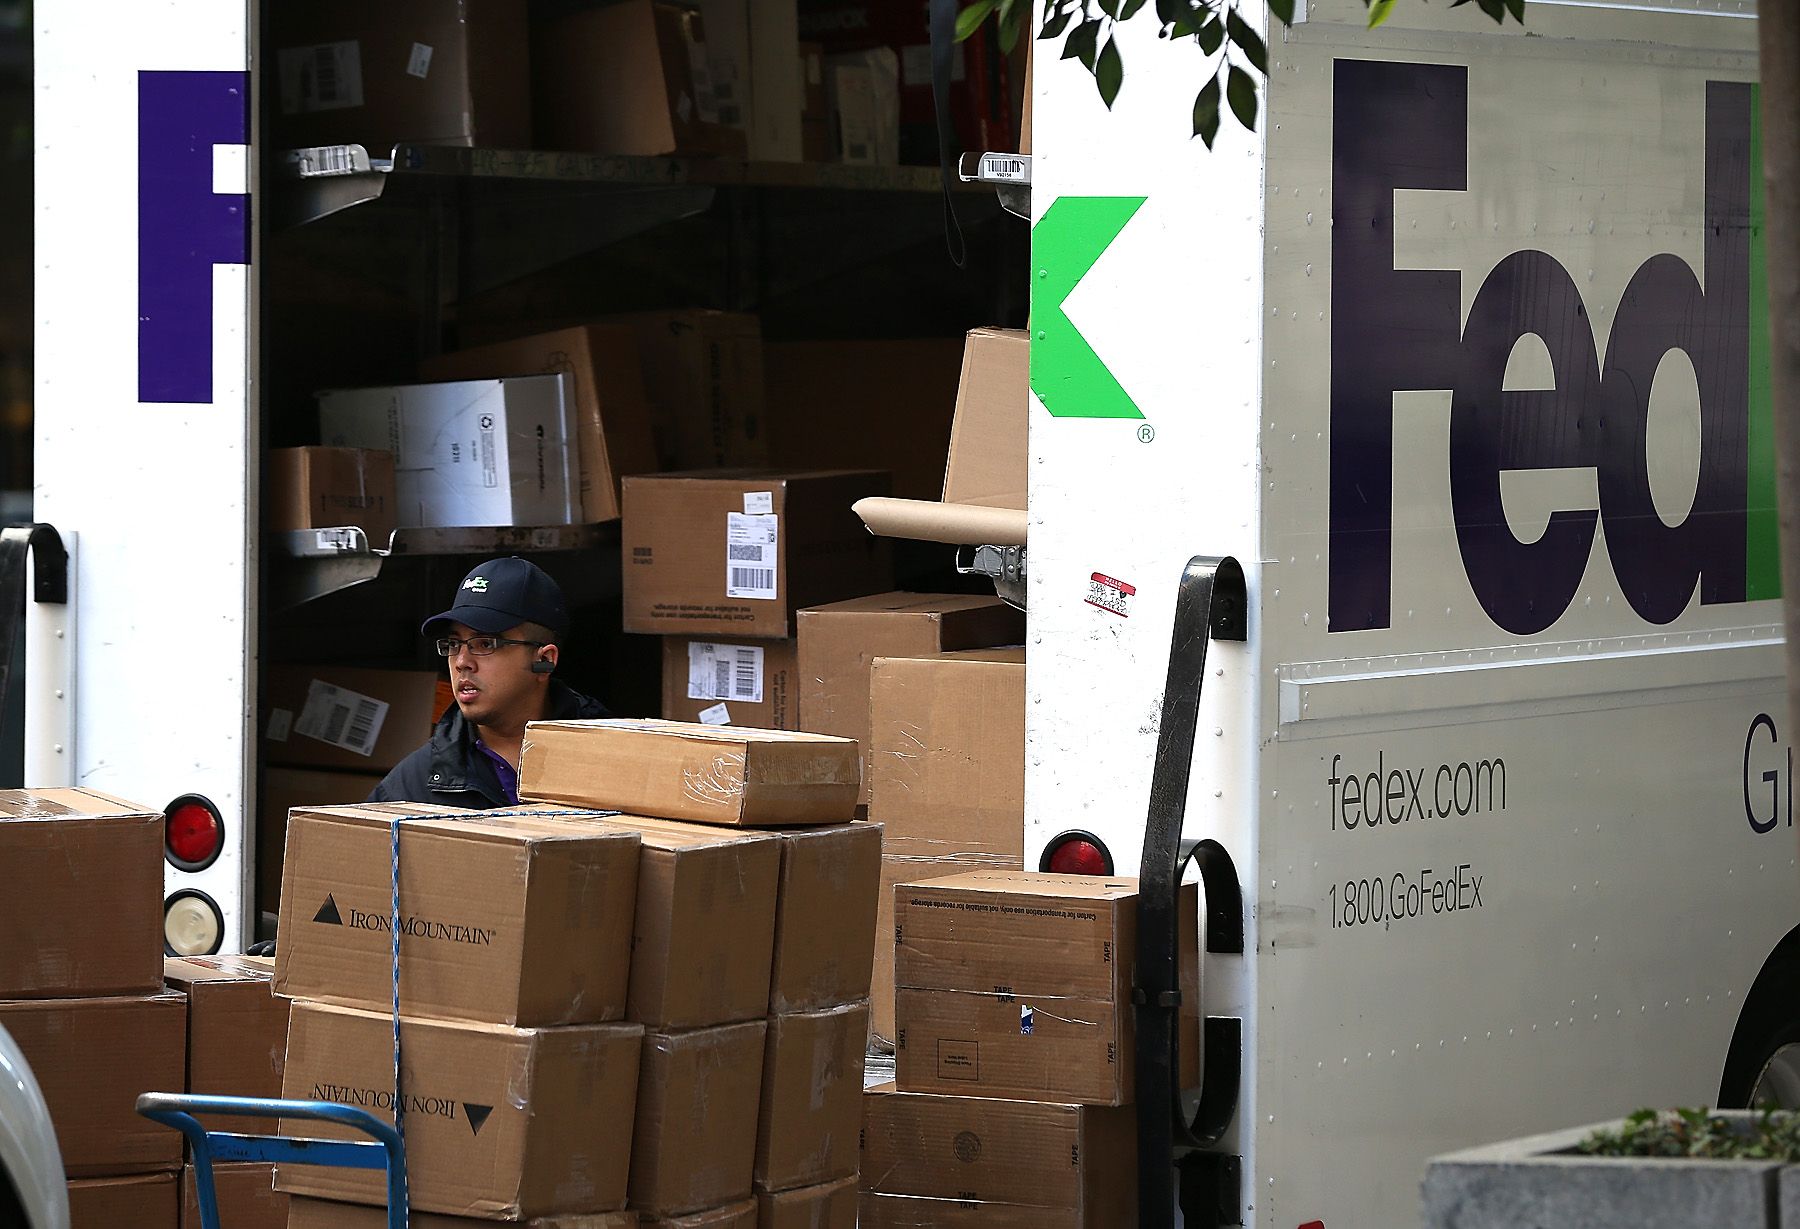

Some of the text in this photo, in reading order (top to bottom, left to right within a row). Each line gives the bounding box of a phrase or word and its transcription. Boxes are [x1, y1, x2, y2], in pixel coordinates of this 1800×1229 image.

[1328, 751, 1507, 831] fedex.com
[934, 901, 956, 910] records
[966, 903, 988, 912] suitable
[989, 905, 999, 913] not
[1026, 908, 1067, 919] transportation
[1067, 911, 1076, 919] for
[1076, 912, 1097, 921] Carton
[350, 909, 392, 933] IRON
[1103, 941, 1111, 963] TAPE
[994, 985, 1012, 993] TAPE
[997, 995, 1015, 1003] TAPE
[898, 1028, 906, 1050] TAPE
[1107, 1042, 1116, 1065] TAPE
[412, 1095, 456, 1119] IRON
[1071, 1144, 1079, 1166] TAPE
